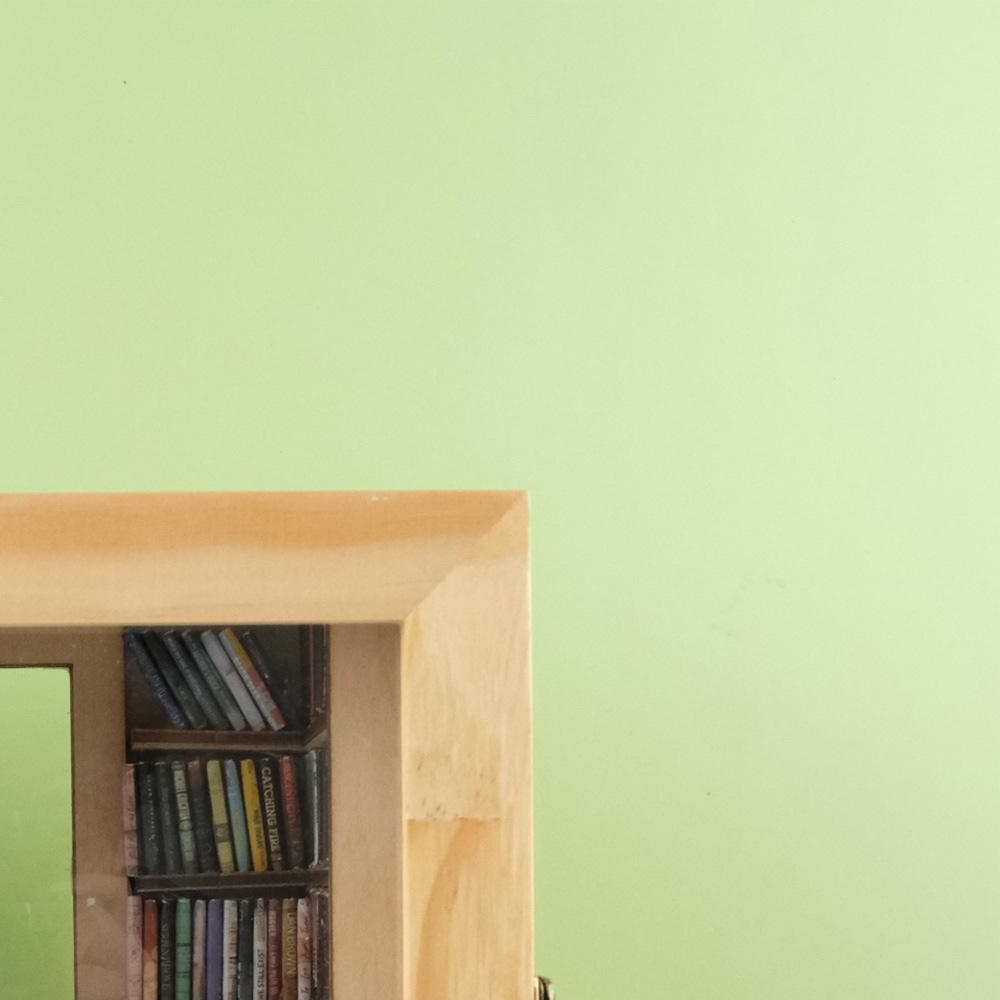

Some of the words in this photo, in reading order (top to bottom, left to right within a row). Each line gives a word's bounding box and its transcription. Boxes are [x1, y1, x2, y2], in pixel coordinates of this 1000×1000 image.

[261, 767, 276, 826] CATCHING
[268, 827, 281, 852] FIRE
[257, 949, 265, 968] EXIST
[257, 969, 265, 988] STILL
